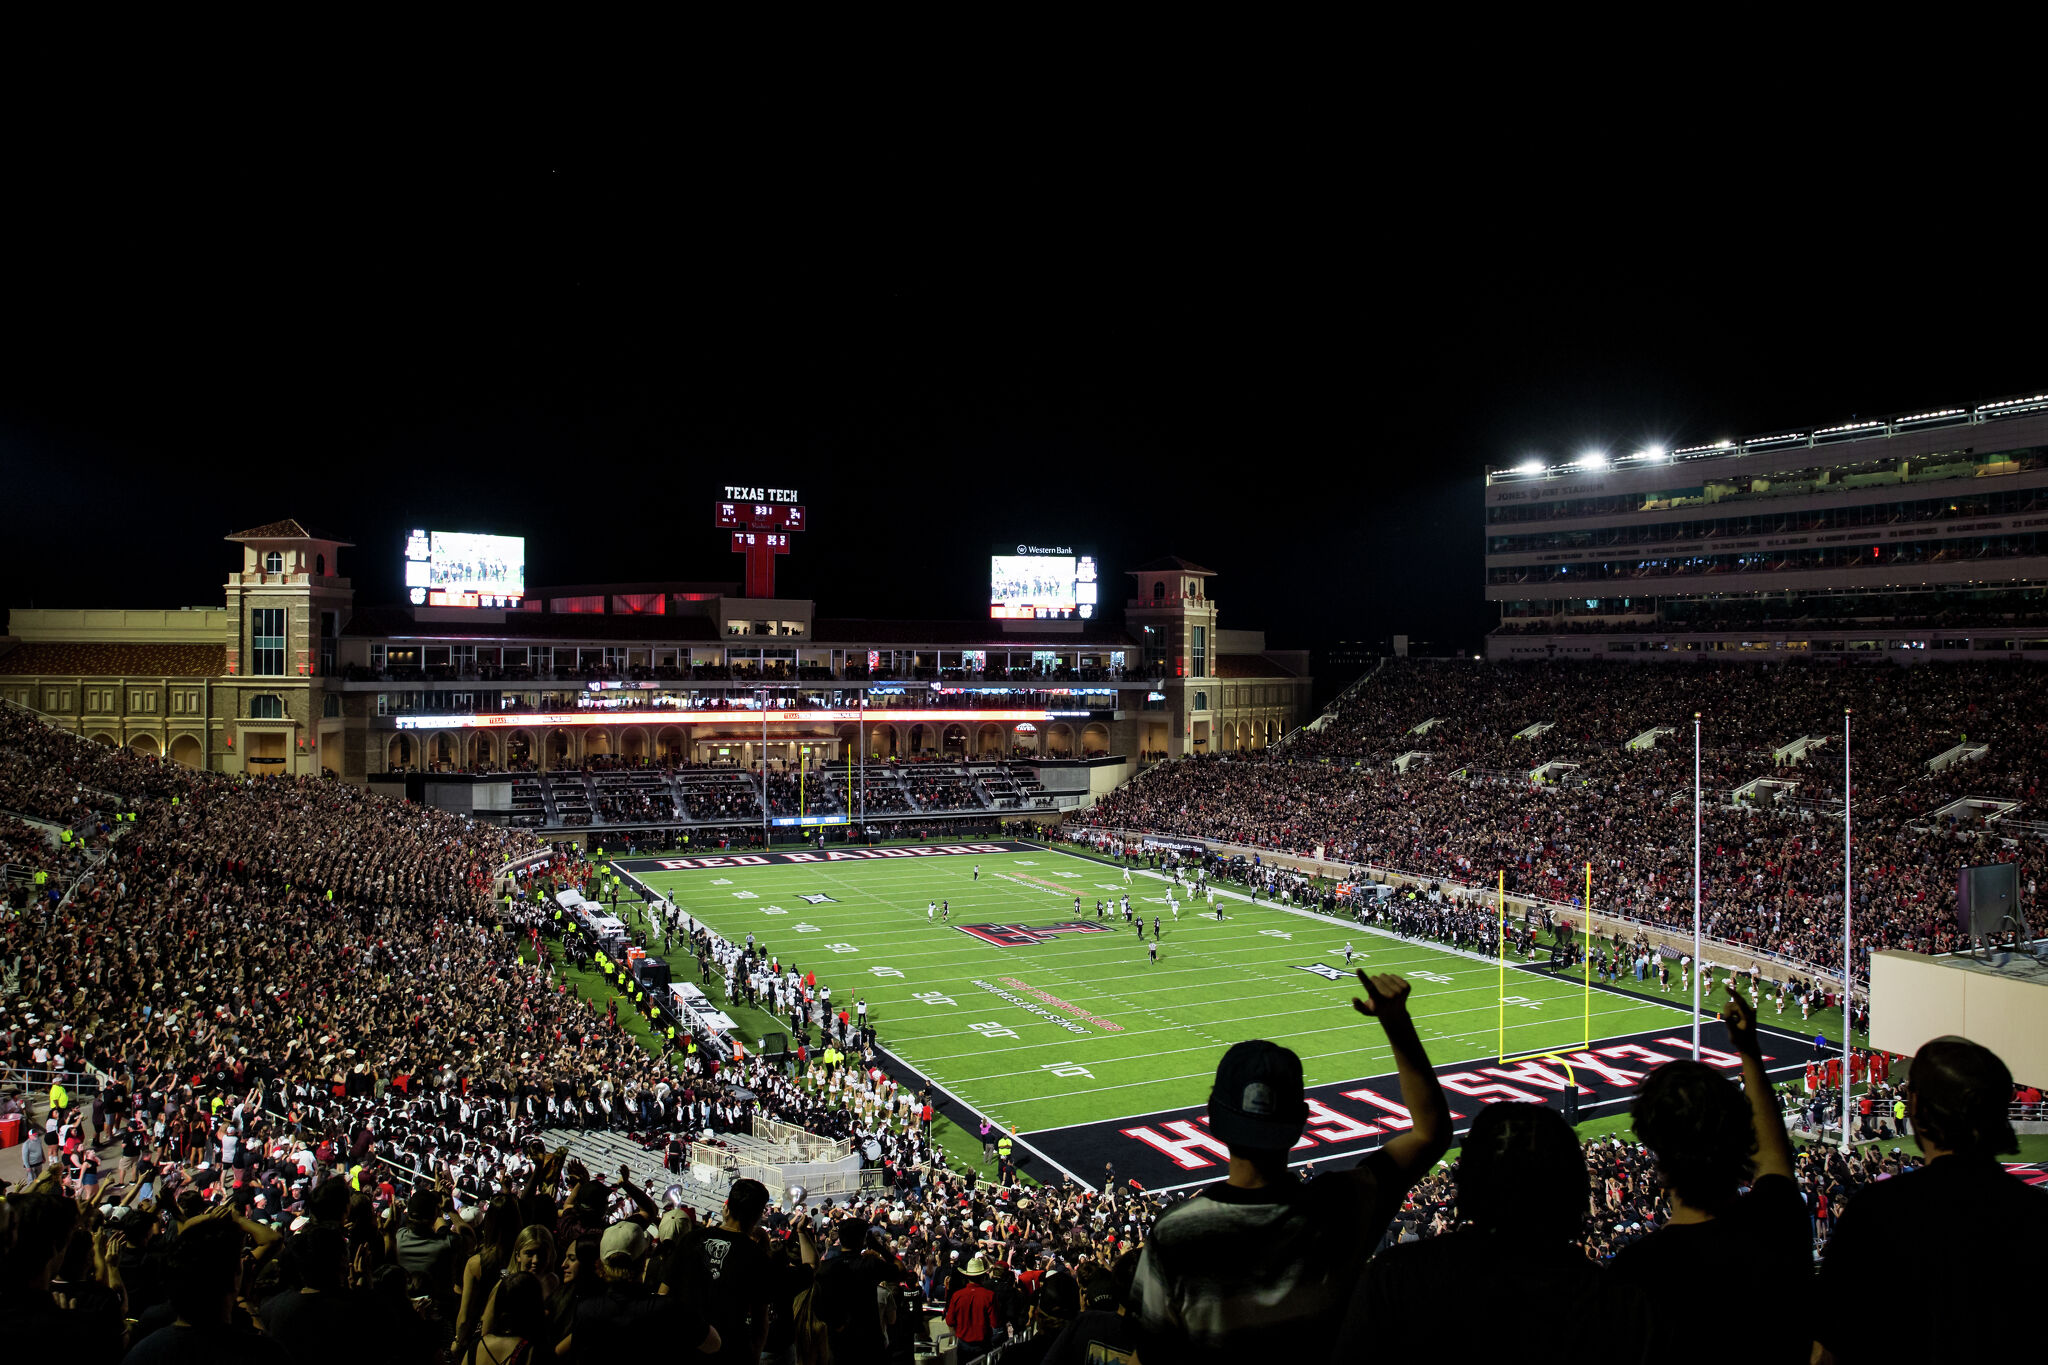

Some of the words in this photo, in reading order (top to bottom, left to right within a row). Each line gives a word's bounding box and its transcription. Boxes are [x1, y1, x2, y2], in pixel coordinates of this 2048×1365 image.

[725, 486, 764, 501] TEXAS
[768, 488, 798, 502] TECH
[1028, 546, 1056, 554] Western
[1056, 546, 1072, 554] Bank
[588, 682, 600, 692] 40
[930, 682, 941, 691] 40
[655, 855, 771, 870] RED
[780, 843, 1012, 862] RAIDERS
[824, 943, 860, 953] 50
[912, 991, 954, 1006] 30
[970, 979, 1024, 1007] STADIUM
[968, 1021, 1013, 1038] 20
[1043, 1013, 1094, 1035] JONES
[1040, 1061, 1090, 1077] 10
[1117, 1088, 1466, 1171] TEH
[333, 1141, 339, 1155] 5
